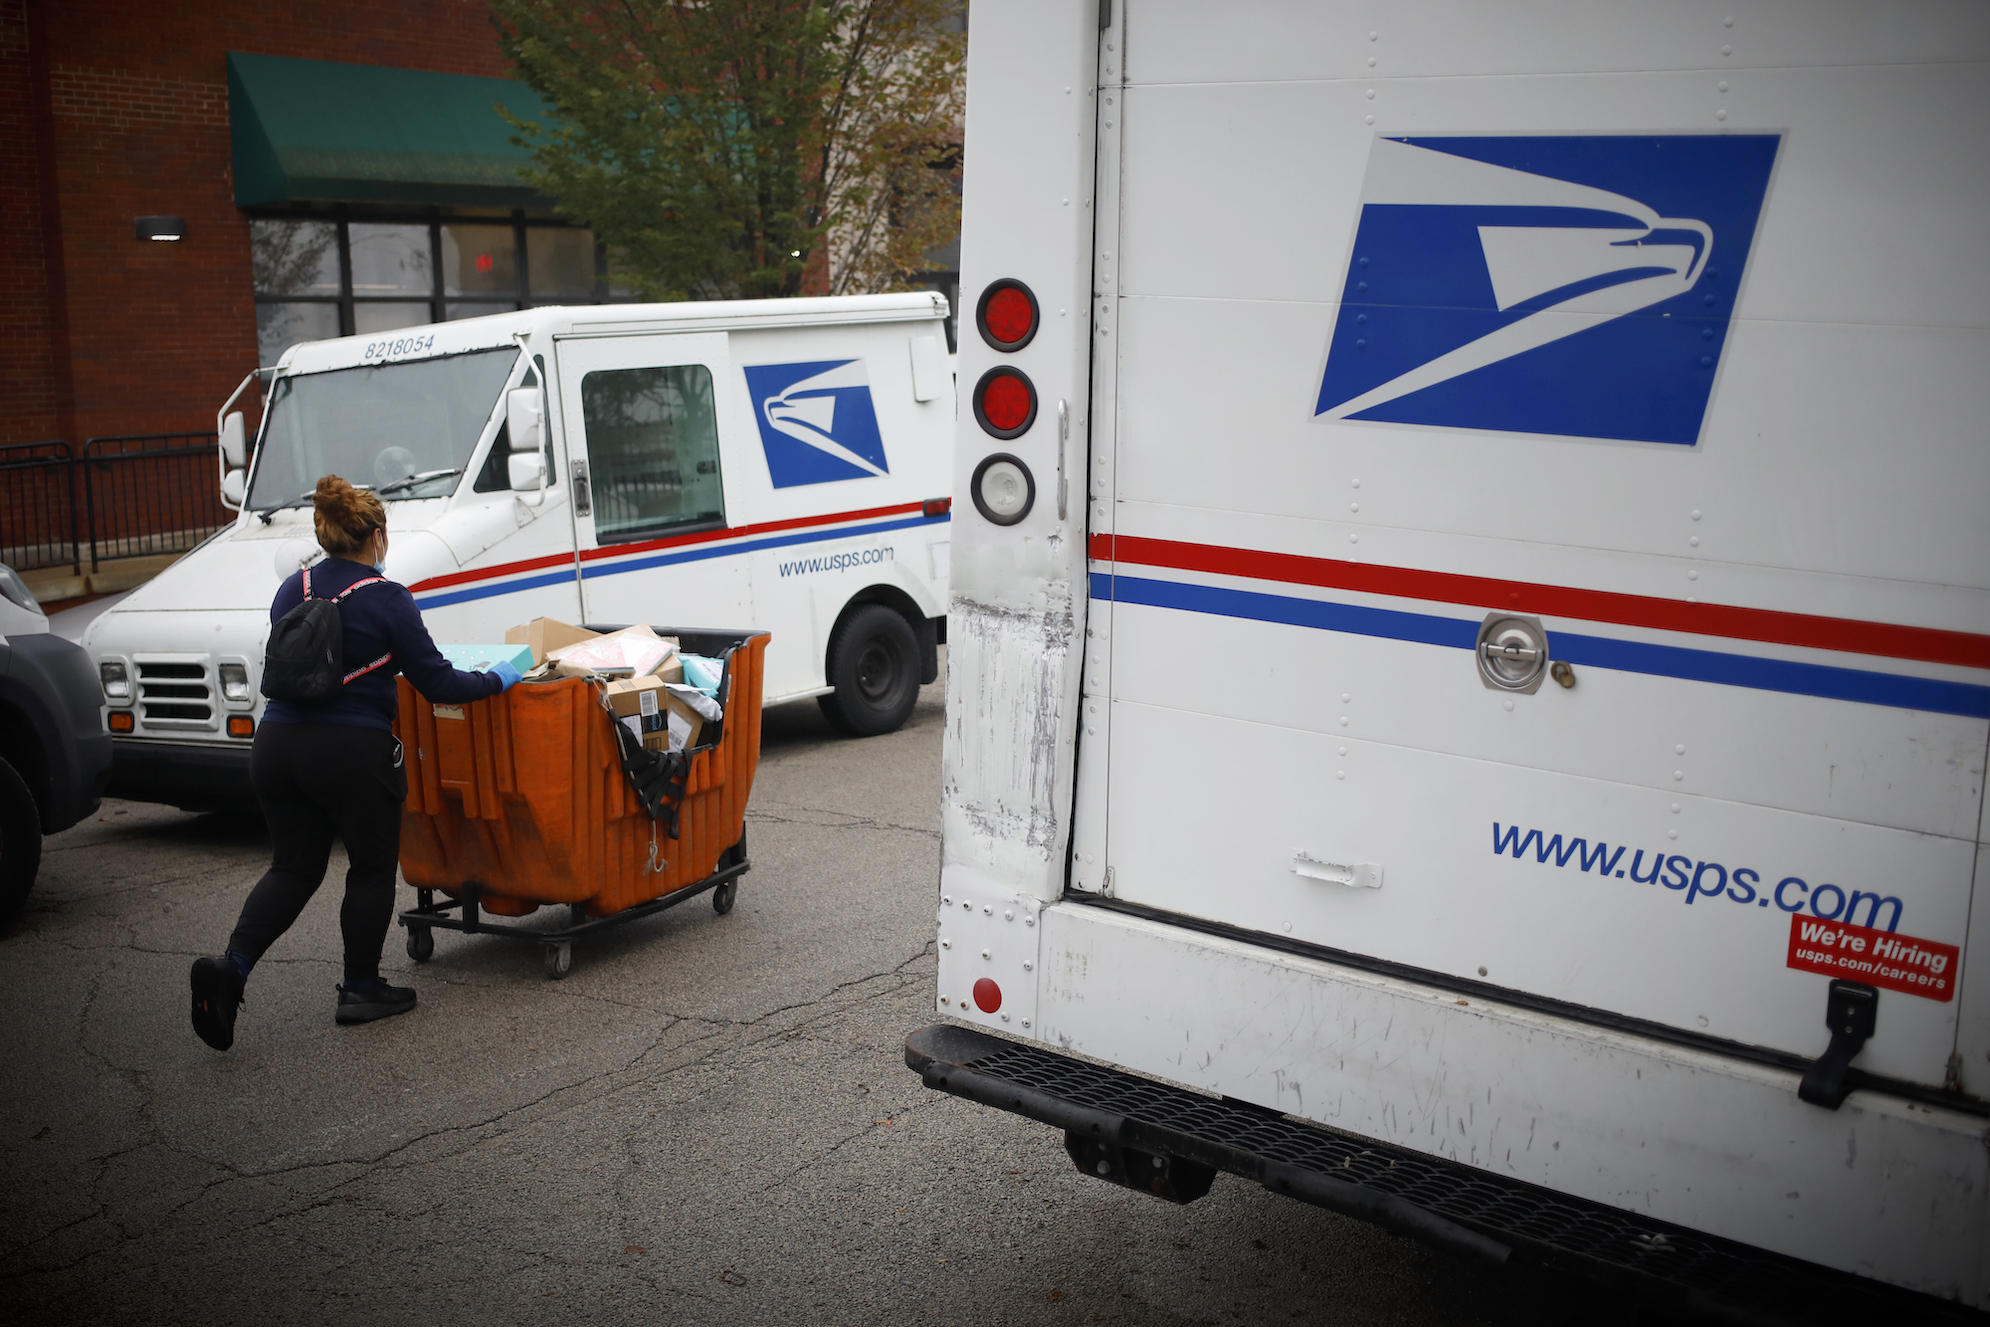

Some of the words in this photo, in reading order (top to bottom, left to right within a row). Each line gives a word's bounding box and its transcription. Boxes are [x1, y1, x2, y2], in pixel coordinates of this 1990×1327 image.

[365, 334, 435, 359] 8218054
[779, 547, 894, 577] www.usps.com
[1493, 822, 1904, 932] www.usps.com
[1800, 921, 1866, 952] We're
[1872, 937, 1949, 974] Hiring
[1796, 948, 1946, 989] usps.com/careers
